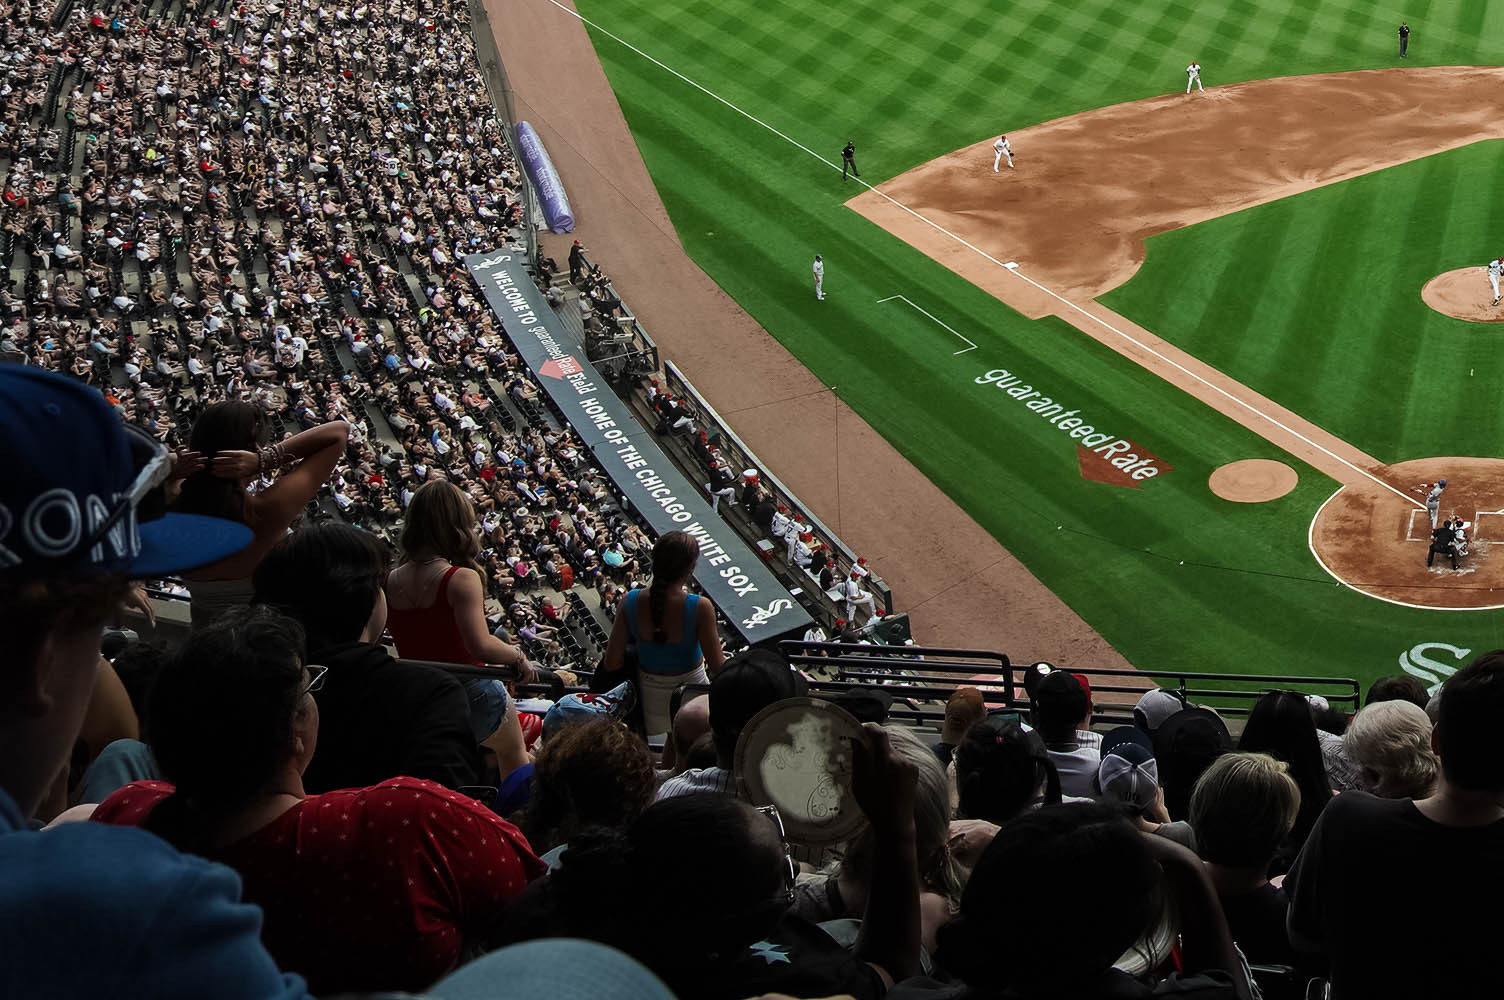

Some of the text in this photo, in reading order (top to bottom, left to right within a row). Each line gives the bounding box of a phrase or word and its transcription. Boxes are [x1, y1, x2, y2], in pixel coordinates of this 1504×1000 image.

[492, 270, 759, 598] WELCOME TO guaranteed Rate Field HOME OF THE CHICAGO WHITE SOX
[974, 368, 1159, 481] guaranteed Rate
